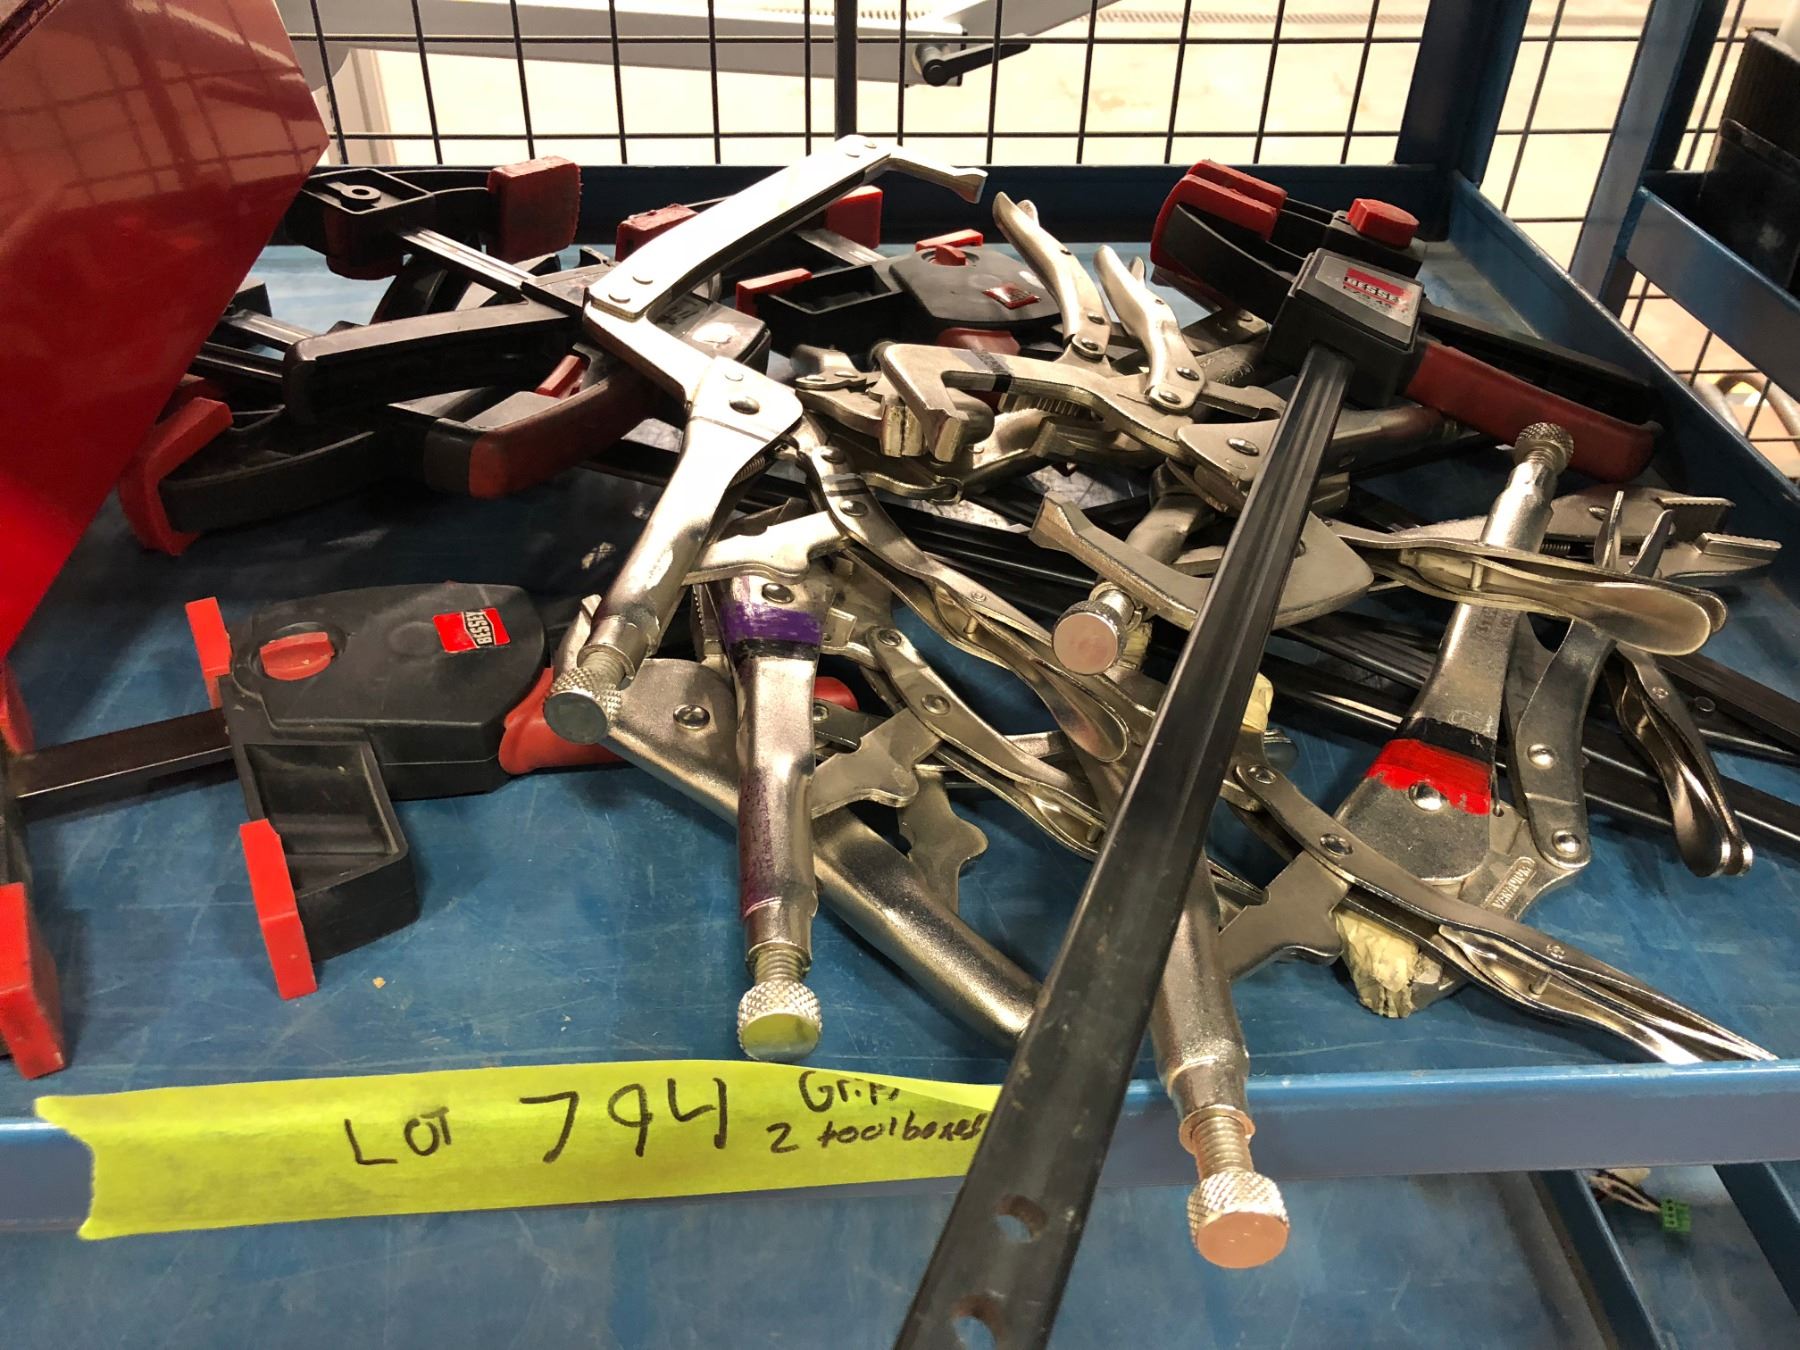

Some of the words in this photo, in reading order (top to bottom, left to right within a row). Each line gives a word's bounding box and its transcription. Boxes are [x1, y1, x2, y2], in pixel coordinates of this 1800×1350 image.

[465, 611, 492, 645] BESSEY
[344, 1106, 452, 1165] LOT
[518, 1077, 728, 1163] 794
[766, 1121, 800, 1154] 2
